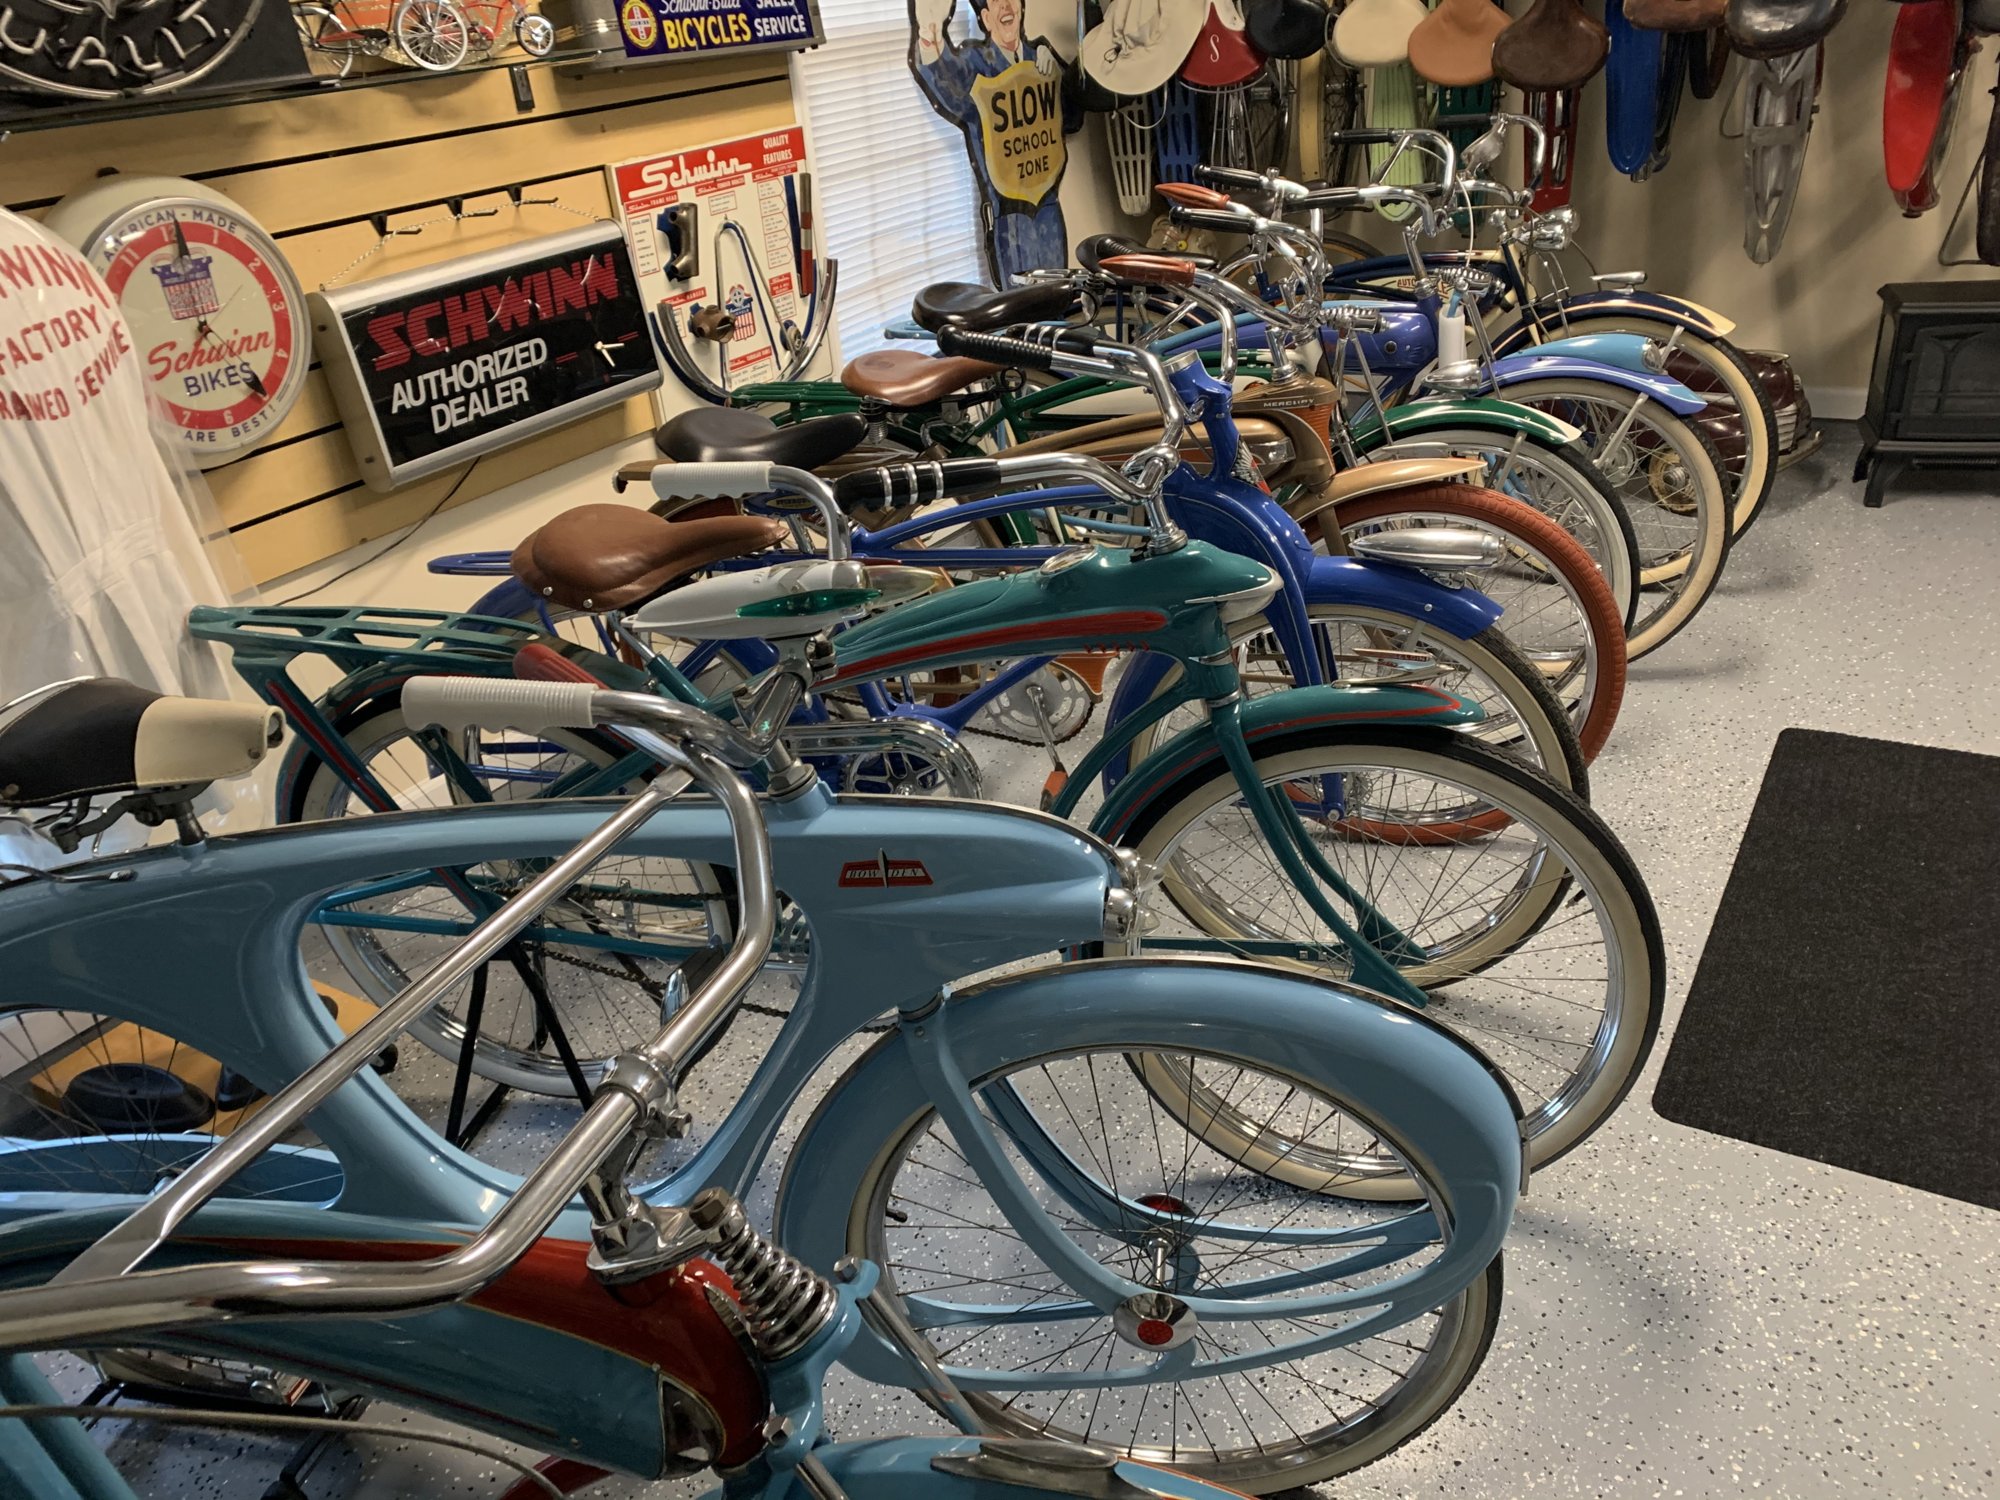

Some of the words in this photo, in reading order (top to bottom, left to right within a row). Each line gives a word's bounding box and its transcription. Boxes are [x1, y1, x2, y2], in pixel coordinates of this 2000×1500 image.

[0, 0, 217, 76] UALIT
[662, 13, 752, 49] BICYCLES
[754, 14, 807, 38] SERVICE
[1210, 33, 1220, 63] S
[991, 81, 1056, 133] SLOW
[763, 133, 789, 149] QUALITY
[1003, 128, 1057, 158] SCHOOL
[763, 148, 793, 165] FEATURES
[1017, 155, 1050, 179] ZONE
[628, 149, 752, 199] Schwinn
[212, 229, 219, 244] 1
[120, 247, 140, 268] 11
[248, 258, 261, 272] 2
[0, 244, 110, 310] WINN
[273, 301, 285, 312] 3
[367, 253, 619, 371] SCHWINN
[148, 329, 272, 381] Schwinn
[275, 348, 288, 359] 4
[183, 361, 256, 397] BIKES
[391, 337, 548, 414] AUTHORIZED
[181, 411, 192, 425] 7
[223, 410, 234, 424] 6
[431, 376, 530, 434] DEALER
[1263, 398, 1315, 408] MERCURY
[184, 430, 217, 443] ARE
[231, 404, 277, 438] BEST!
